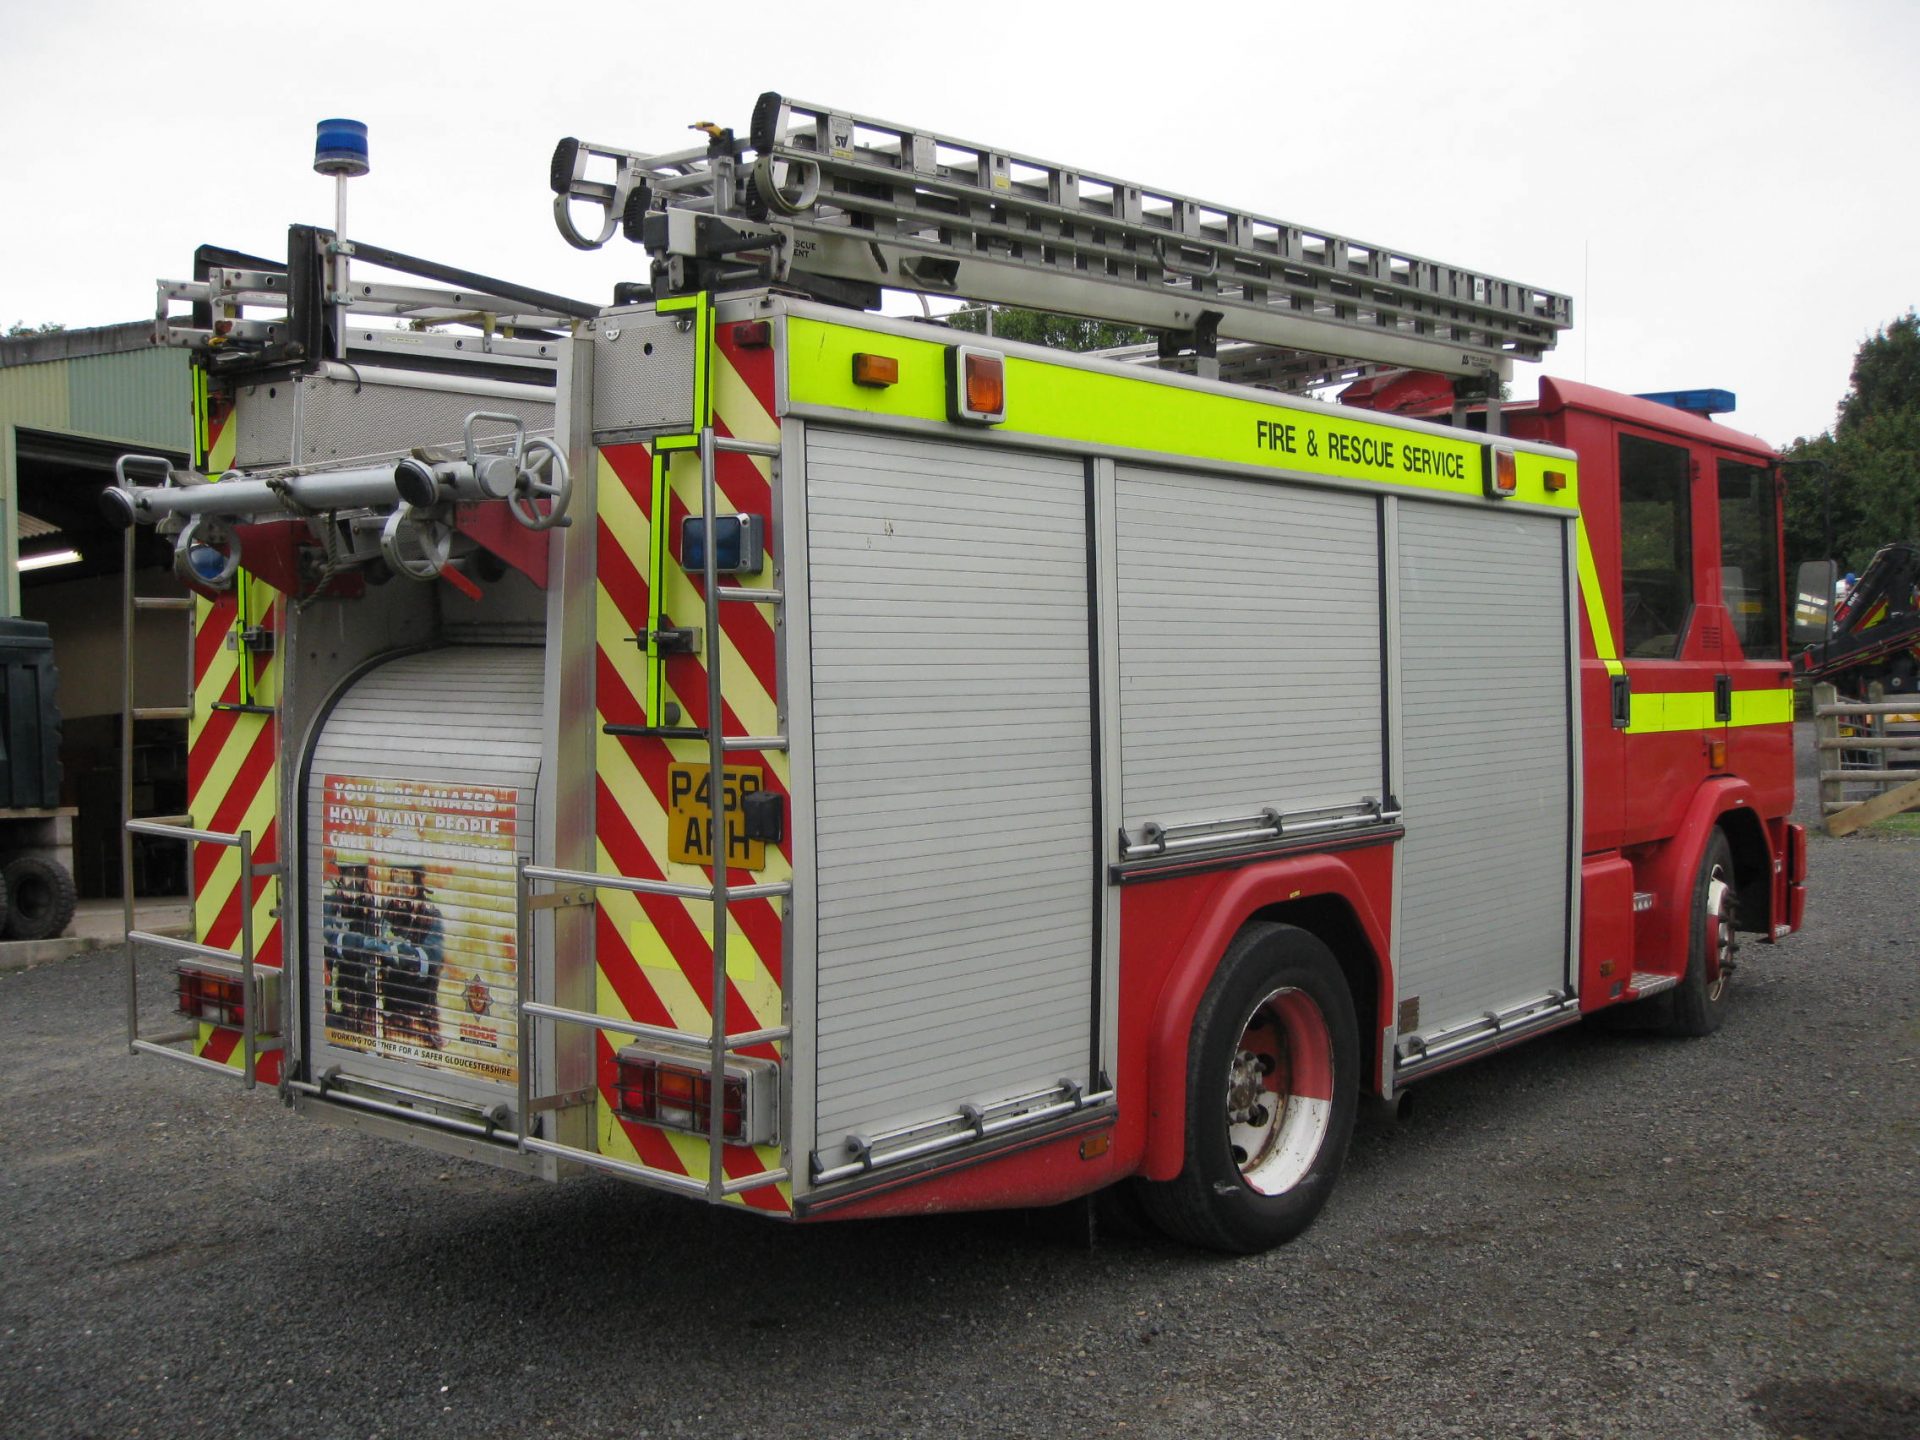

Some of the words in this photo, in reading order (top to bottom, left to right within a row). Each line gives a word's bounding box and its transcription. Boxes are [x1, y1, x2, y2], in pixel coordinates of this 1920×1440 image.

[1257, 420, 1297, 453] FIRE
[1307, 429, 1319, 457] &
[1328, 432, 1394, 468] RESCUE
[1403, 445, 1465, 479] SERVICE
[334, 782, 385, 803] YOU'D
[394, 787, 413, 806] BE
[421, 789, 496, 812] AMAZED
[329, 806, 368, 826] HOW
[377, 810, 427, 831] MANY
[435, 816, 500, 838] PEOPLE
[331, 1031, 362, 1046] WORKING
[399, 1045, 412, 1055] FOR
[414, 1048, 419, 1057] A
[421, 1049, 443, 1063] SAFER
[445, 1053, 512, 1077] GLOUCESTERSHIRE
